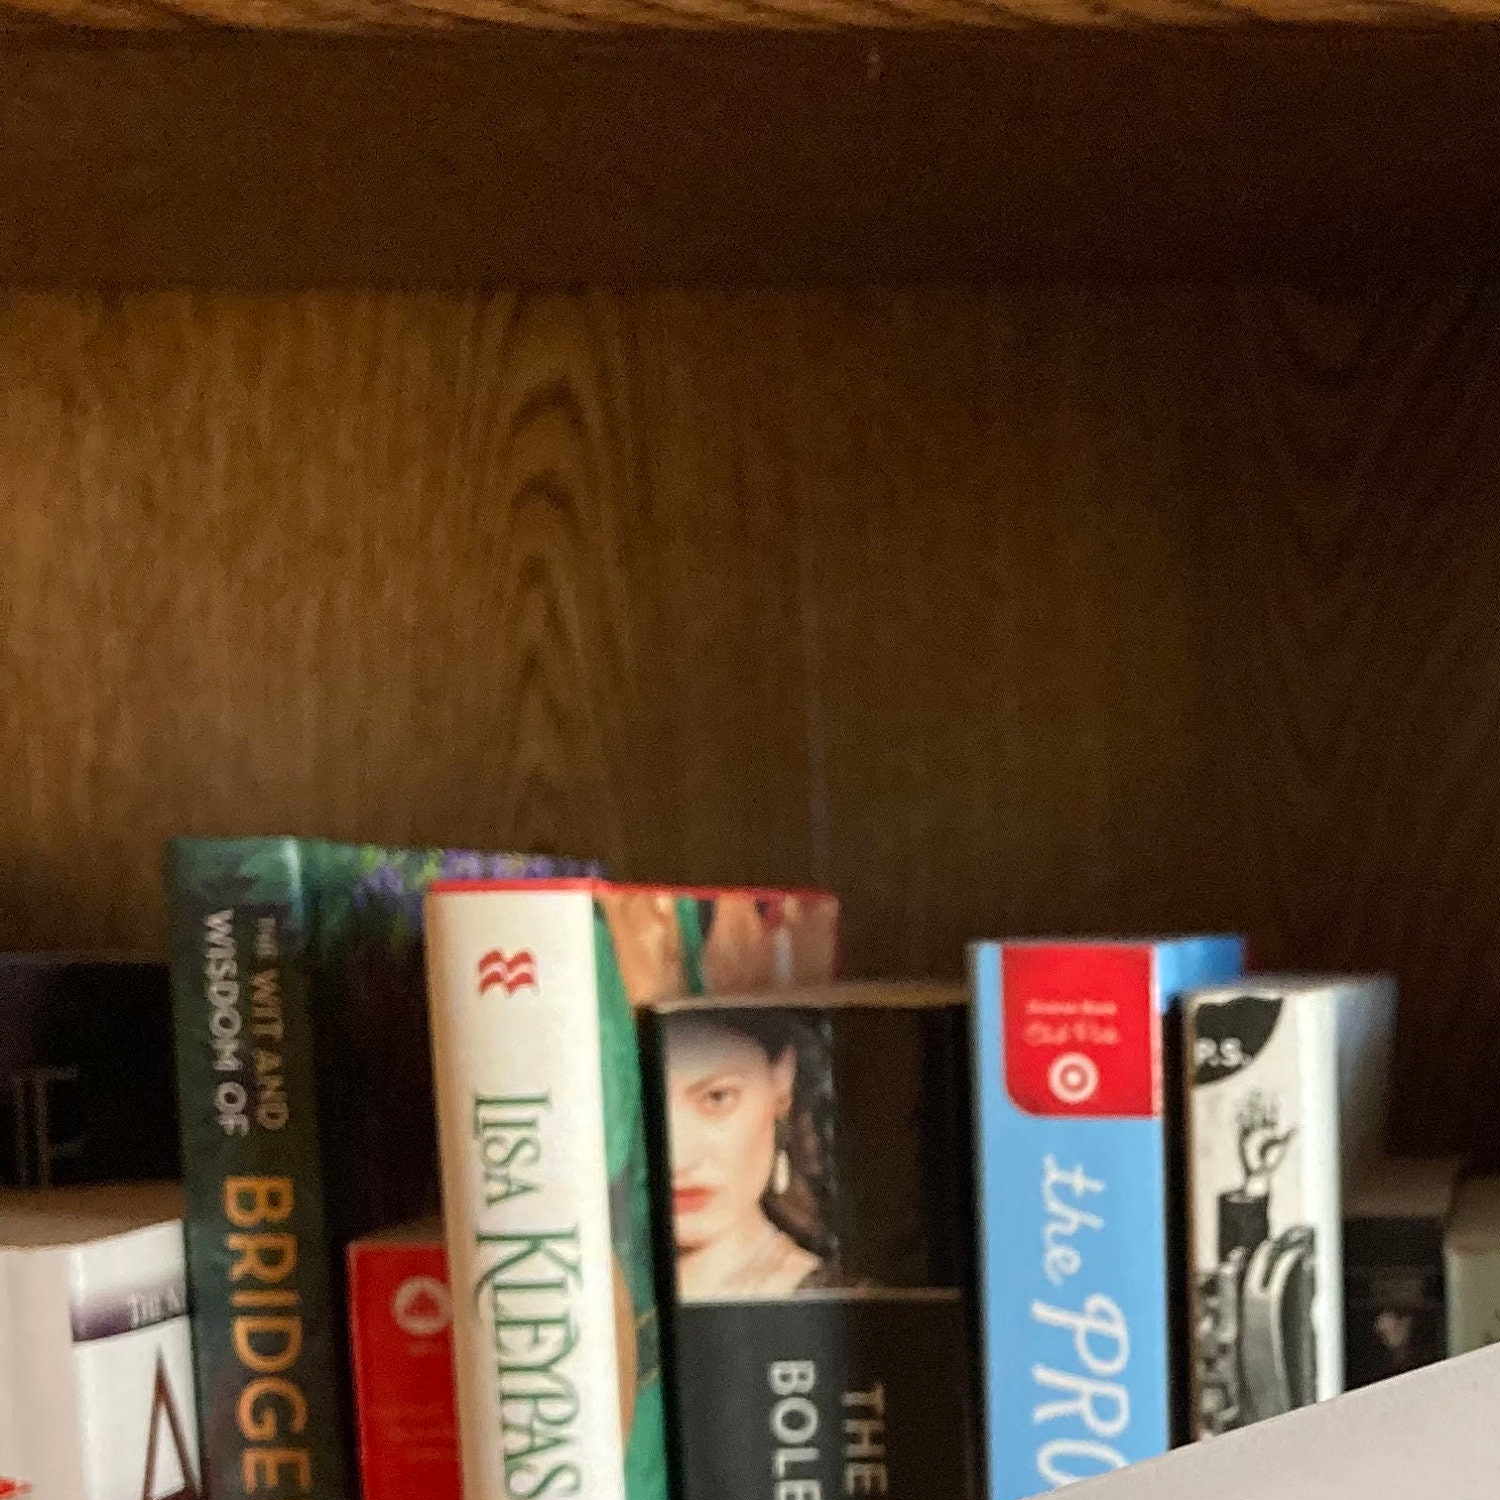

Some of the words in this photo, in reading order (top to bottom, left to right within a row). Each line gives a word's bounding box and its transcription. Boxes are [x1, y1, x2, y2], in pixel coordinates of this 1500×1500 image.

[204, 908, 242, 1072] WISDOM
[251, 966, 285, 1041] WIT
[214, 1080, 250, 1137] OF
[254, 1049, 290, 1131] AND
[473, 1089, 550, 1208] LISA
[1040, 1154, 1107, 1286] the
[840, 1382, 888, 1497] THE
